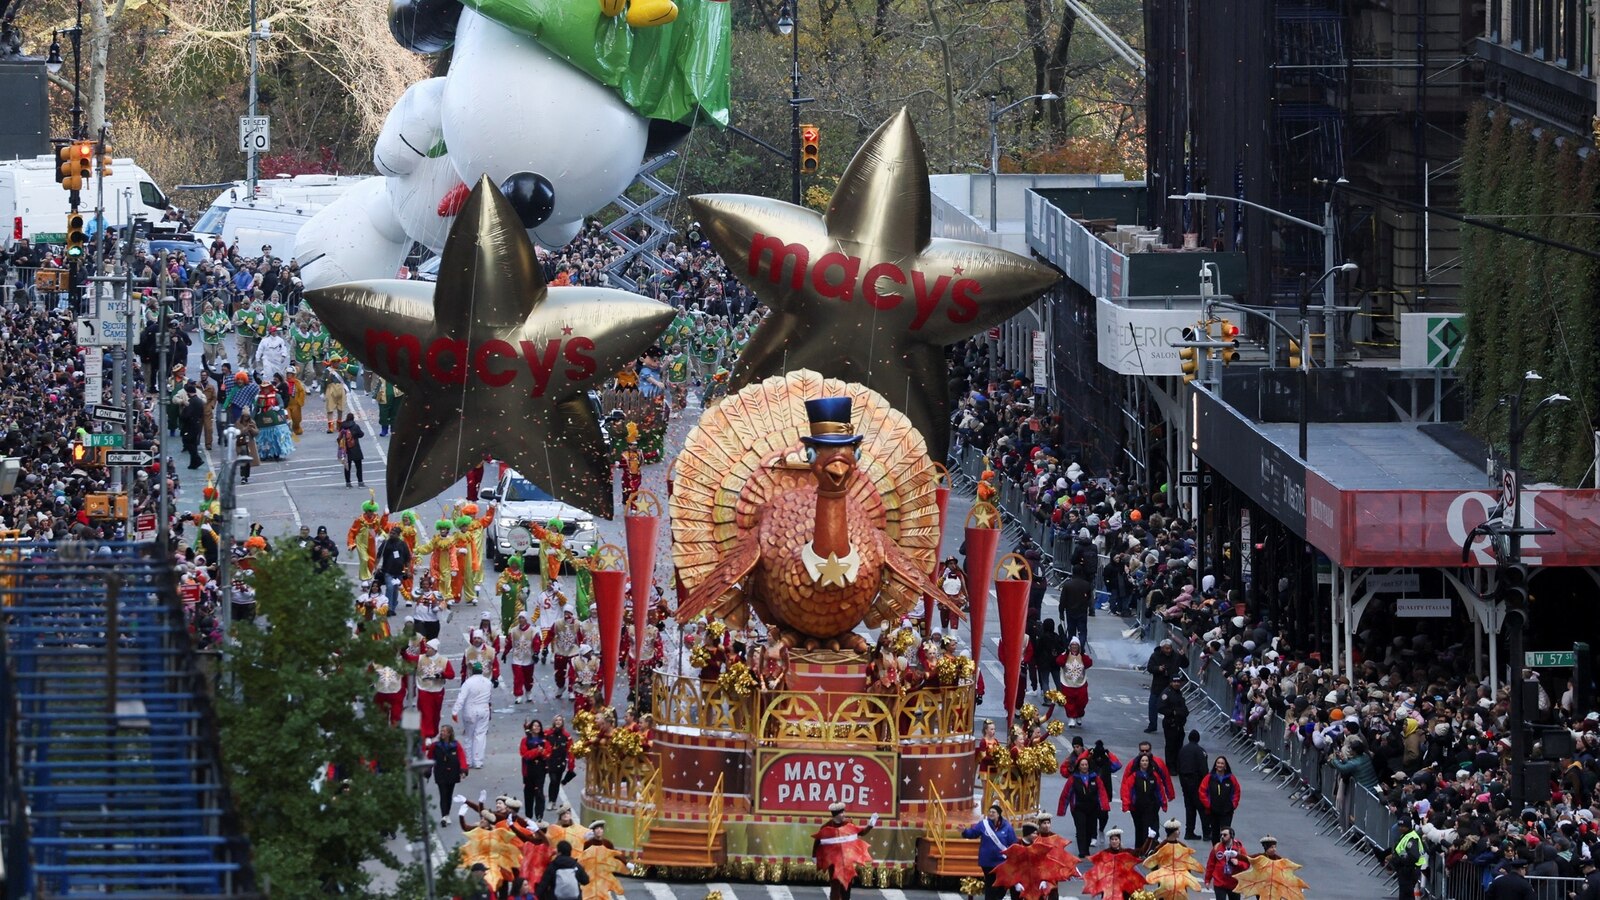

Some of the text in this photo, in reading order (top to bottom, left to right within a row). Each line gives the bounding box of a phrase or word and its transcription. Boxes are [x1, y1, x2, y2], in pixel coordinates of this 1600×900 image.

[93, 436, 100, 445] W
[104, 436, 114, 445] 58
[1536, 654, 1543, 664] W
[1551, 654, 1562, 664] 57
[778, 783, 869, 806] PARADE
